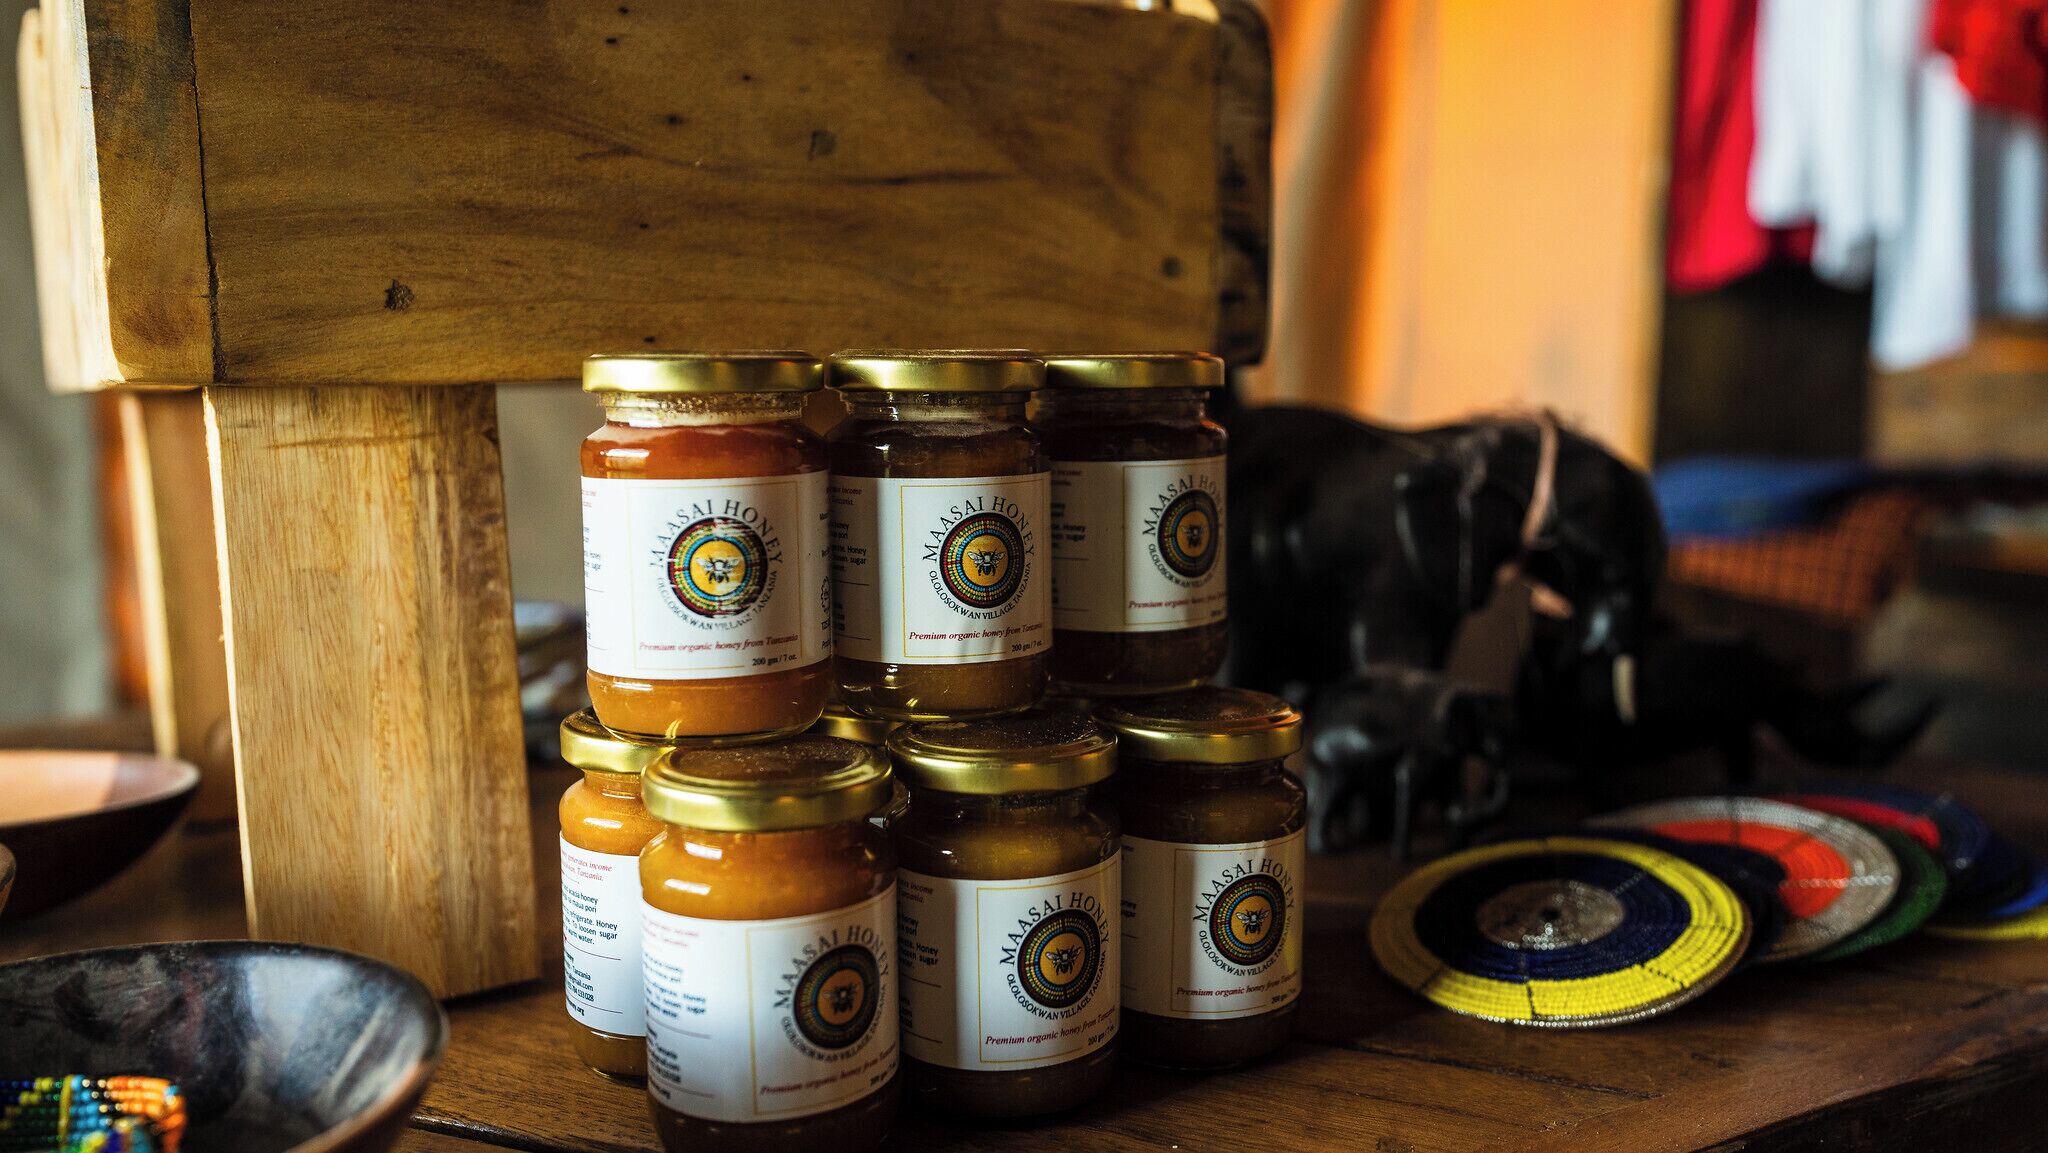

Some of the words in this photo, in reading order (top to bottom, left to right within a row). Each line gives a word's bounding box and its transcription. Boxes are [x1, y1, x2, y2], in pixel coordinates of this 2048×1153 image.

[1142, 474, 1193, 536] MAASAI
[649, 499, 713, 568] MAASAI
[723, 499, 783, 564] HONEY
[922, 496, 985, 563] MAASAI
[991, 495, 1035, 556] HONEY
[929, 570, 981, 620] OLOLOSOKWAN
[982, 603, 1016, 620] VILLAGE
[715, 641, 743, 651] honey
[742, 638, 764, 650] from
[909, 631, 947, 640] Premium
[948, 630, 981, 642] organic
[982, 629, 1005, 638] honey
[581, 892, 599, 905] honey
[1192, 860, 1253, 925] MAASAI
[1259, 858, 1295, 909] HONEY
[585, 903, 597, 914] pori
[596, 919, 618, 931] Honey
[579, 922, 597, 936] loosen
[599, 930, 618, 941] sugar
[999, 894, 1063, 967] MAASAI
[1069, 891, 1110, 945] HONEY
[916, 942, 939, 957] Honey
[1198, 930, 1245, 977] OLOLOSOKWAN
[773, 929, 838, 1009] MAASAI
[846, 925, 889, 977] HONEY
[1006, 973, 1059, 1020] OLOLOSOKWAN
[1176, 986, 1213, 996] Premium
[1214, 986, 1244, 998] organic
[985, 1035, 1025, 1045] Premium
[1026, 1030, 1059, 1043] organic
